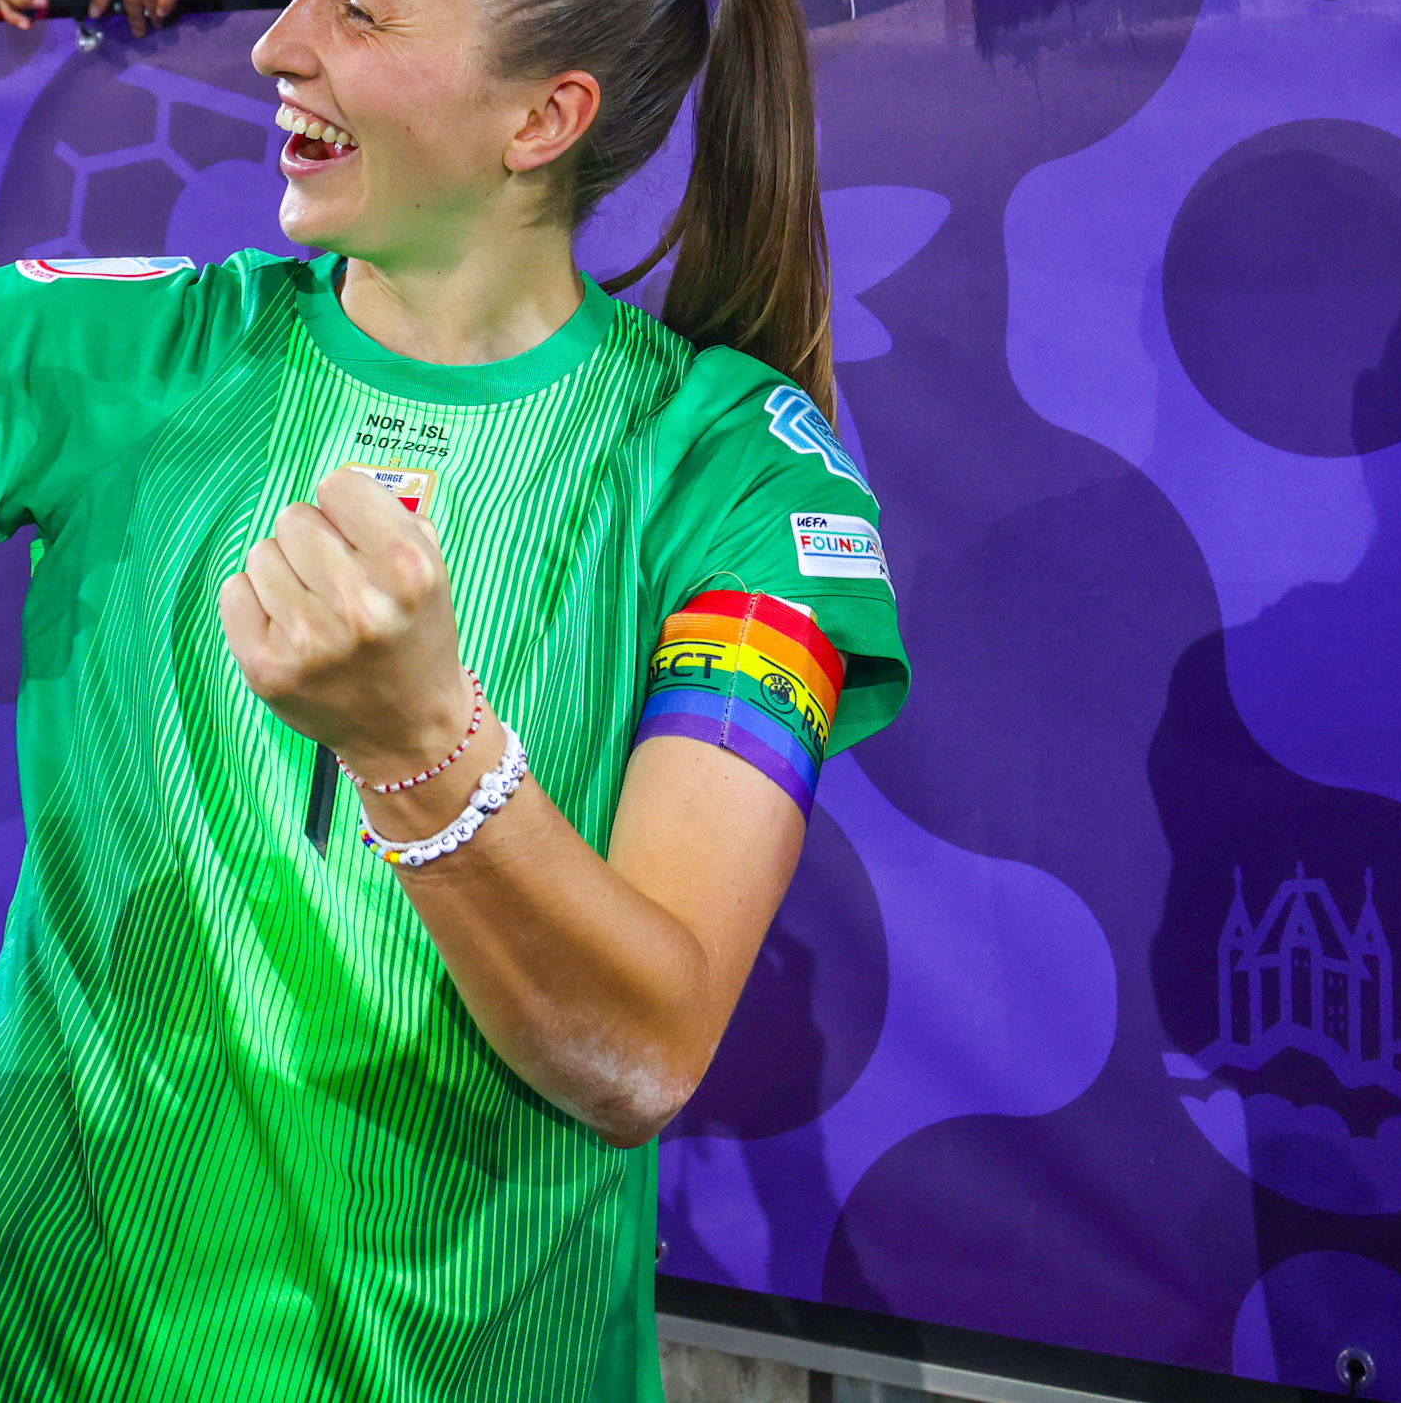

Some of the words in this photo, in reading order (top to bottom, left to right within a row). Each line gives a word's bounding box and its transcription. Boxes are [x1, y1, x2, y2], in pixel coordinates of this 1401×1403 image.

[366, 413, 405, 433] NOR
[420, 424, 449, 441] ISL
[355, 432, 450, 457] 10.07.2025
[375, 472, 404, 483] NORGE
[797, 516, 828, 528] UEFA
